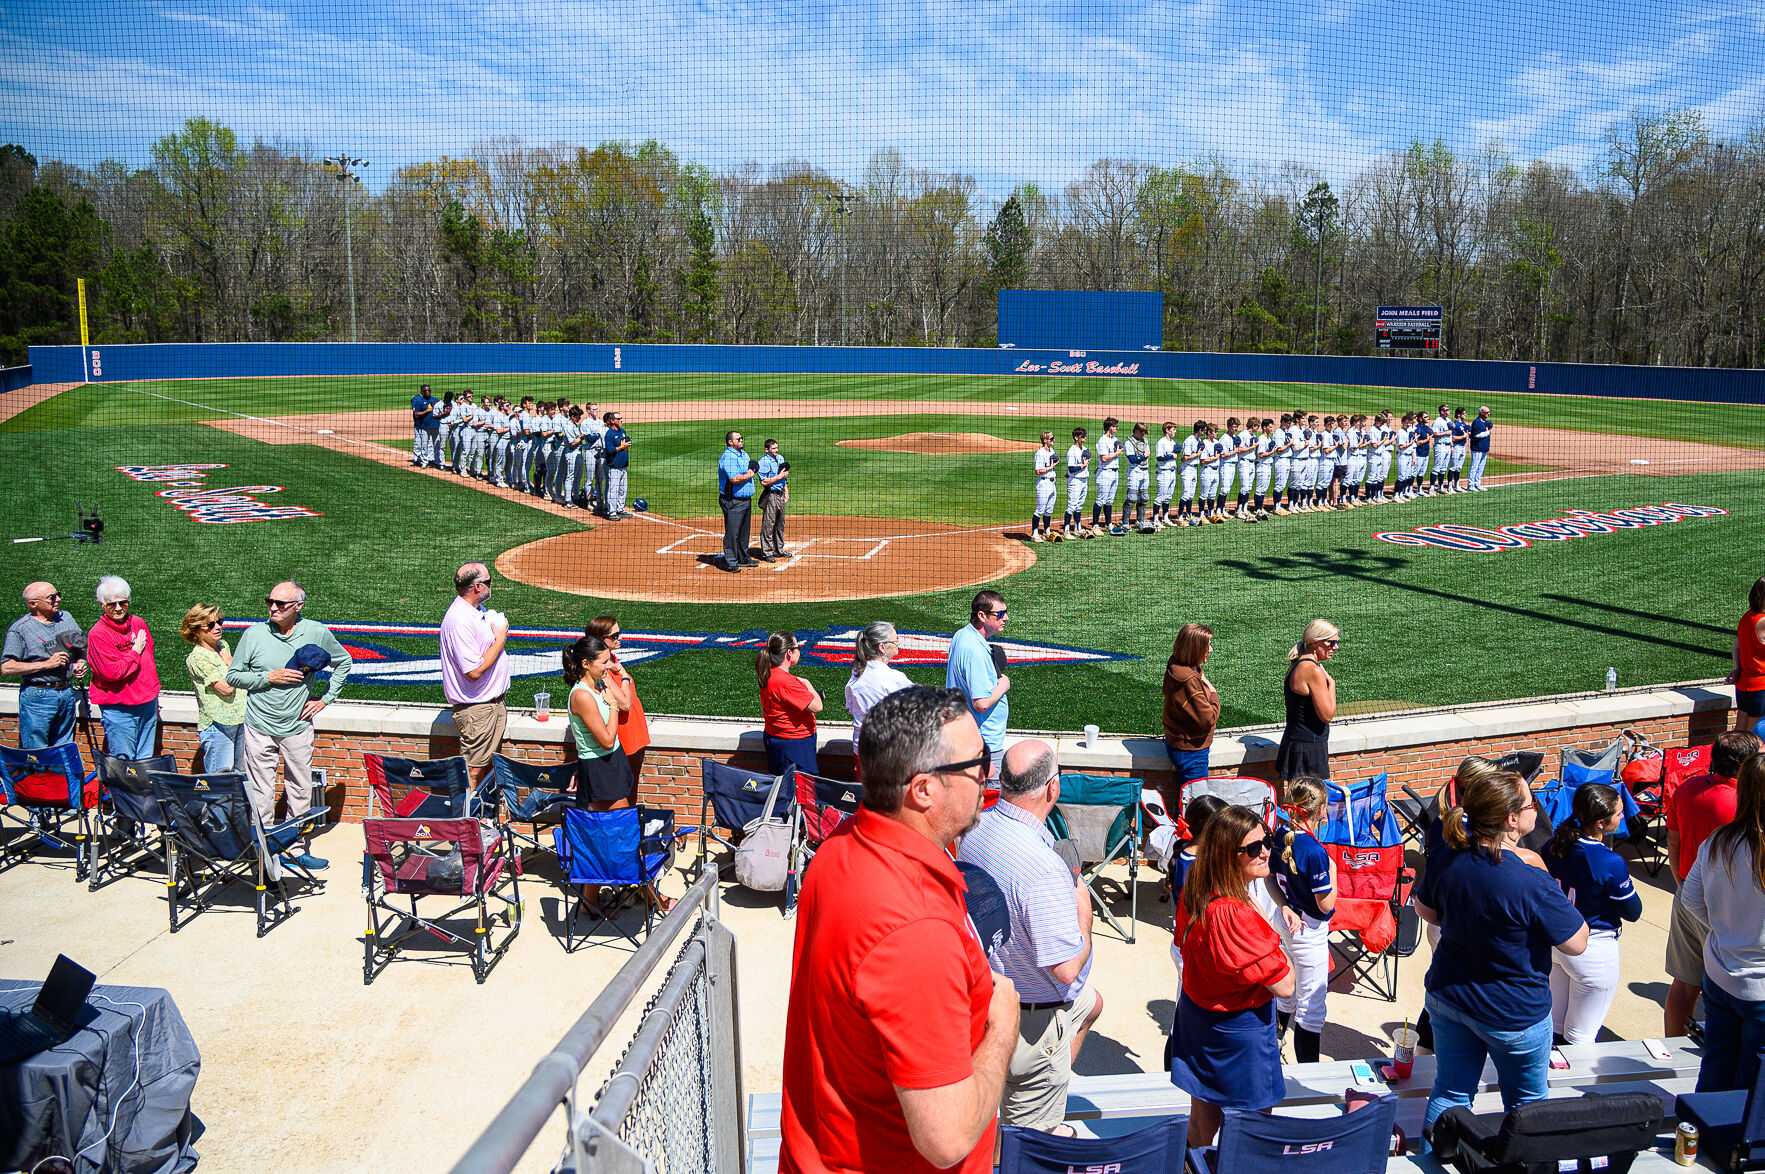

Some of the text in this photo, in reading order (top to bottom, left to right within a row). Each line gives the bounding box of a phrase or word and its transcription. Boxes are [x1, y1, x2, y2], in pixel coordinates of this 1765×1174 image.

[92, 351, 101, 376] 300
[1015, 360, 1139, 374] Lee-Scott Baseball
[1372, 502, 1730, 552] Warriors
[1342, 851, 1380, 861] LSA
[1282, 1141, 1334, 1155] LSA
[1067, 1163, 1121, 1174] LSA
